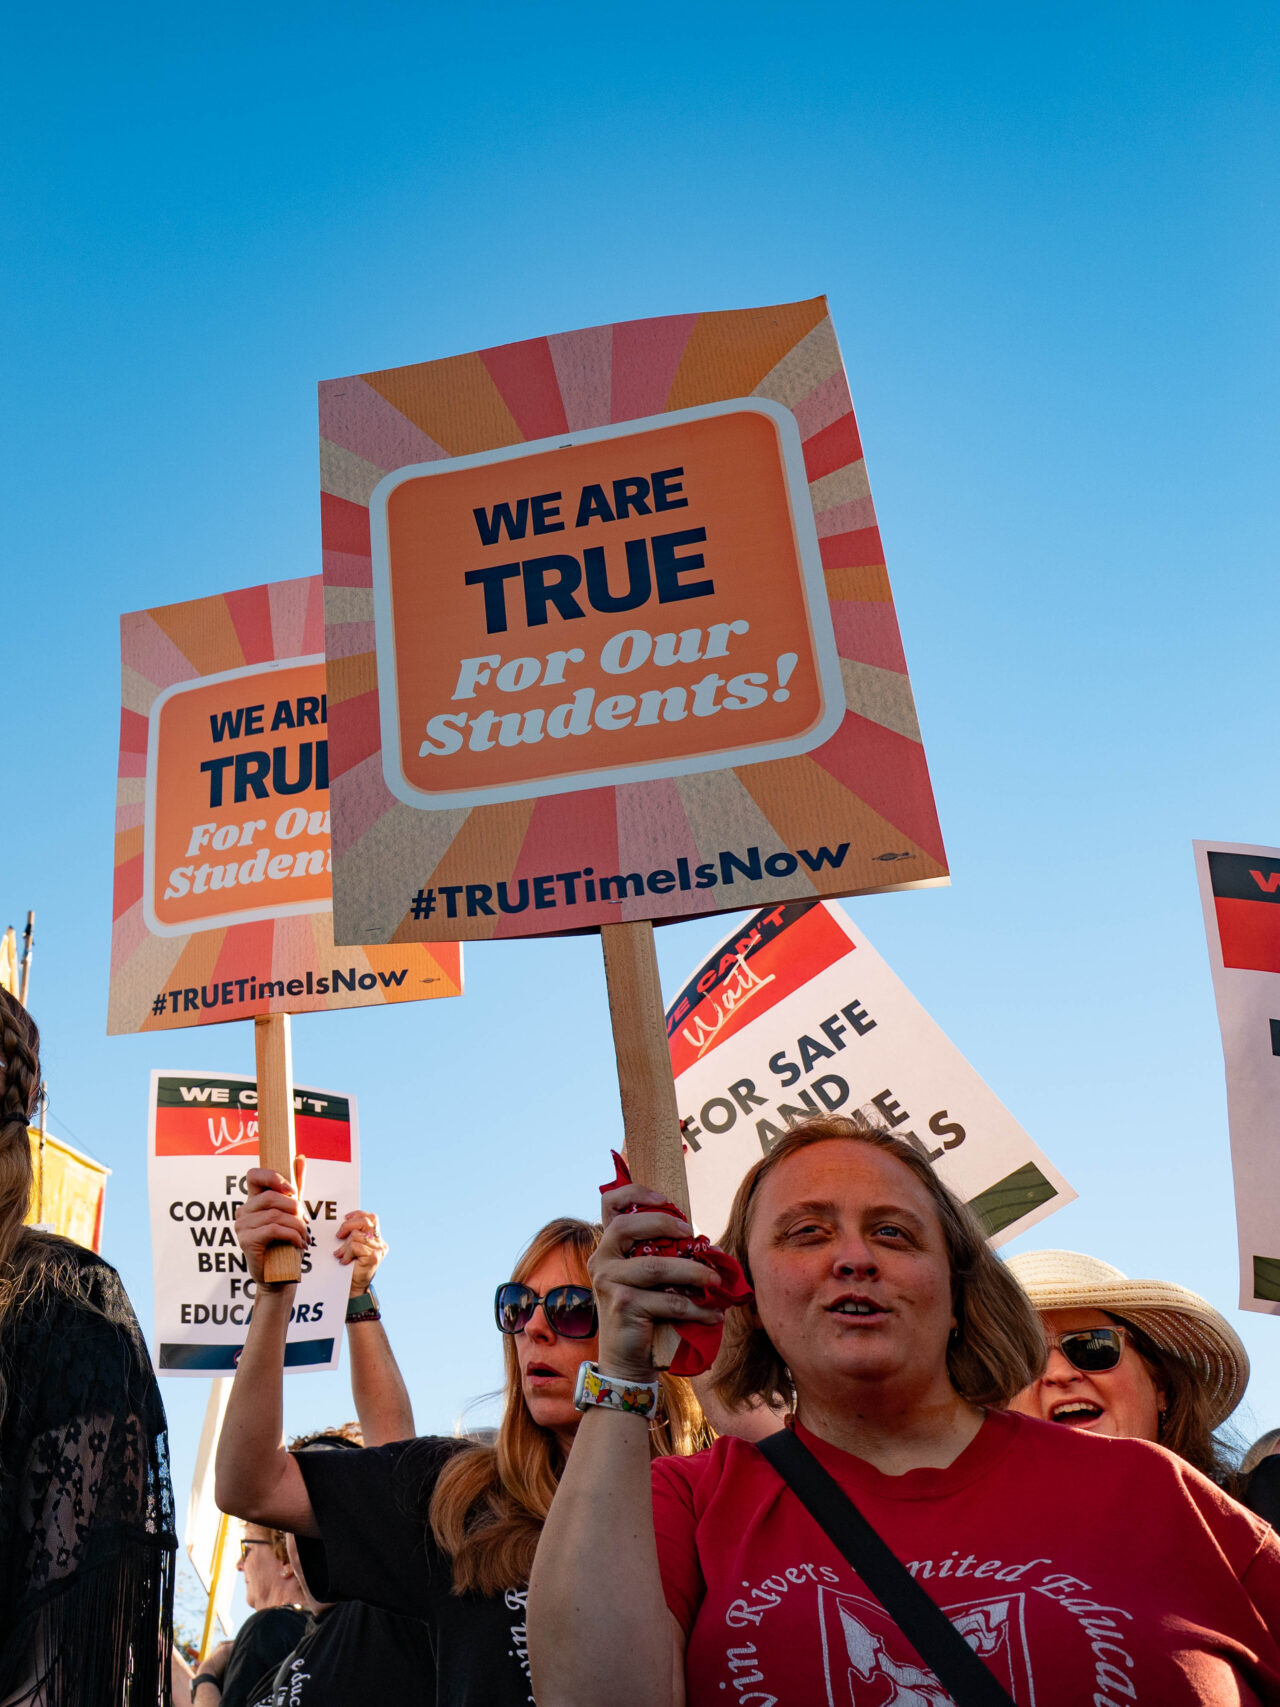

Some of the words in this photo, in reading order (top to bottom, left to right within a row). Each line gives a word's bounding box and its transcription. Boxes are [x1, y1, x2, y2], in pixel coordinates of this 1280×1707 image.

[473, 491, 566, 547] WE
[574, 466, 689, 529] ARE
[464, 526, 716, 635] TRUE
[450, 646, 586, 701] For
[599, 618, 750, 675] Our
[209, 703, 266, 744] WE
[418, 651, 799, 759] Students!
[185, 813, 268, 858] For
[275, 807, 332, 840] Ou
[163, 848, 333, 900] Studen
[410, 842, 851, 921] #TRUETimeIsNow
[1248, 869, 1280, 893] W
[696, 904, 786, 994] CAN'T
[152, 968, 409, 1016] #TRUETimeIsNow
[179, 1086, 230, 1103] WE
[681, 1078, 770, 1153] FOR
[768, 999, 878, 1088] SAFE
[230, 1278, 256, 1300] FO
[725, 1561, 840, 1628] Rivers
[902, 1550, 1053, 1584] nited
[1031, 1573, 1139, 1707] Educa
